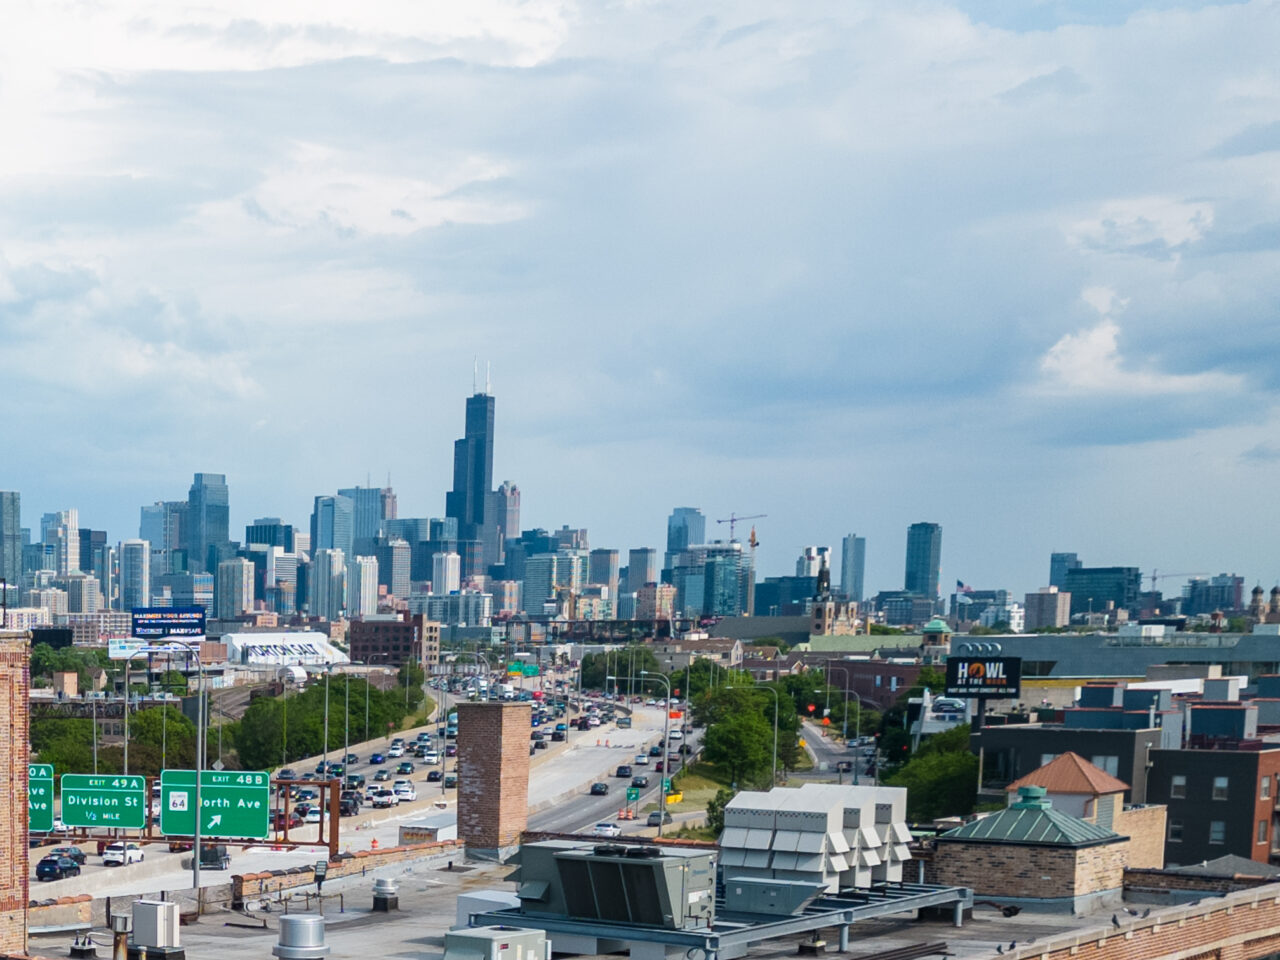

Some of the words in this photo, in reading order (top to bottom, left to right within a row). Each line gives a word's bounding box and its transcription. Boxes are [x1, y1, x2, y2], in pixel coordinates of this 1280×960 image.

[958, 662, 1007, 678] HOWL
[39, 767, 47, 776] A
[111, 779, 128, 788] 49
[130, 779, 139, 788] A
[236, 775, 252, 784] 48
[255, 775, 263, 784] B
[28, 787, 45, 796] ve
[68, 795, 119, 806] Division
[124, 797, 138, 807] St
[171, 799, 185, 808] 64
[237, 798, 261, 809] Ave
